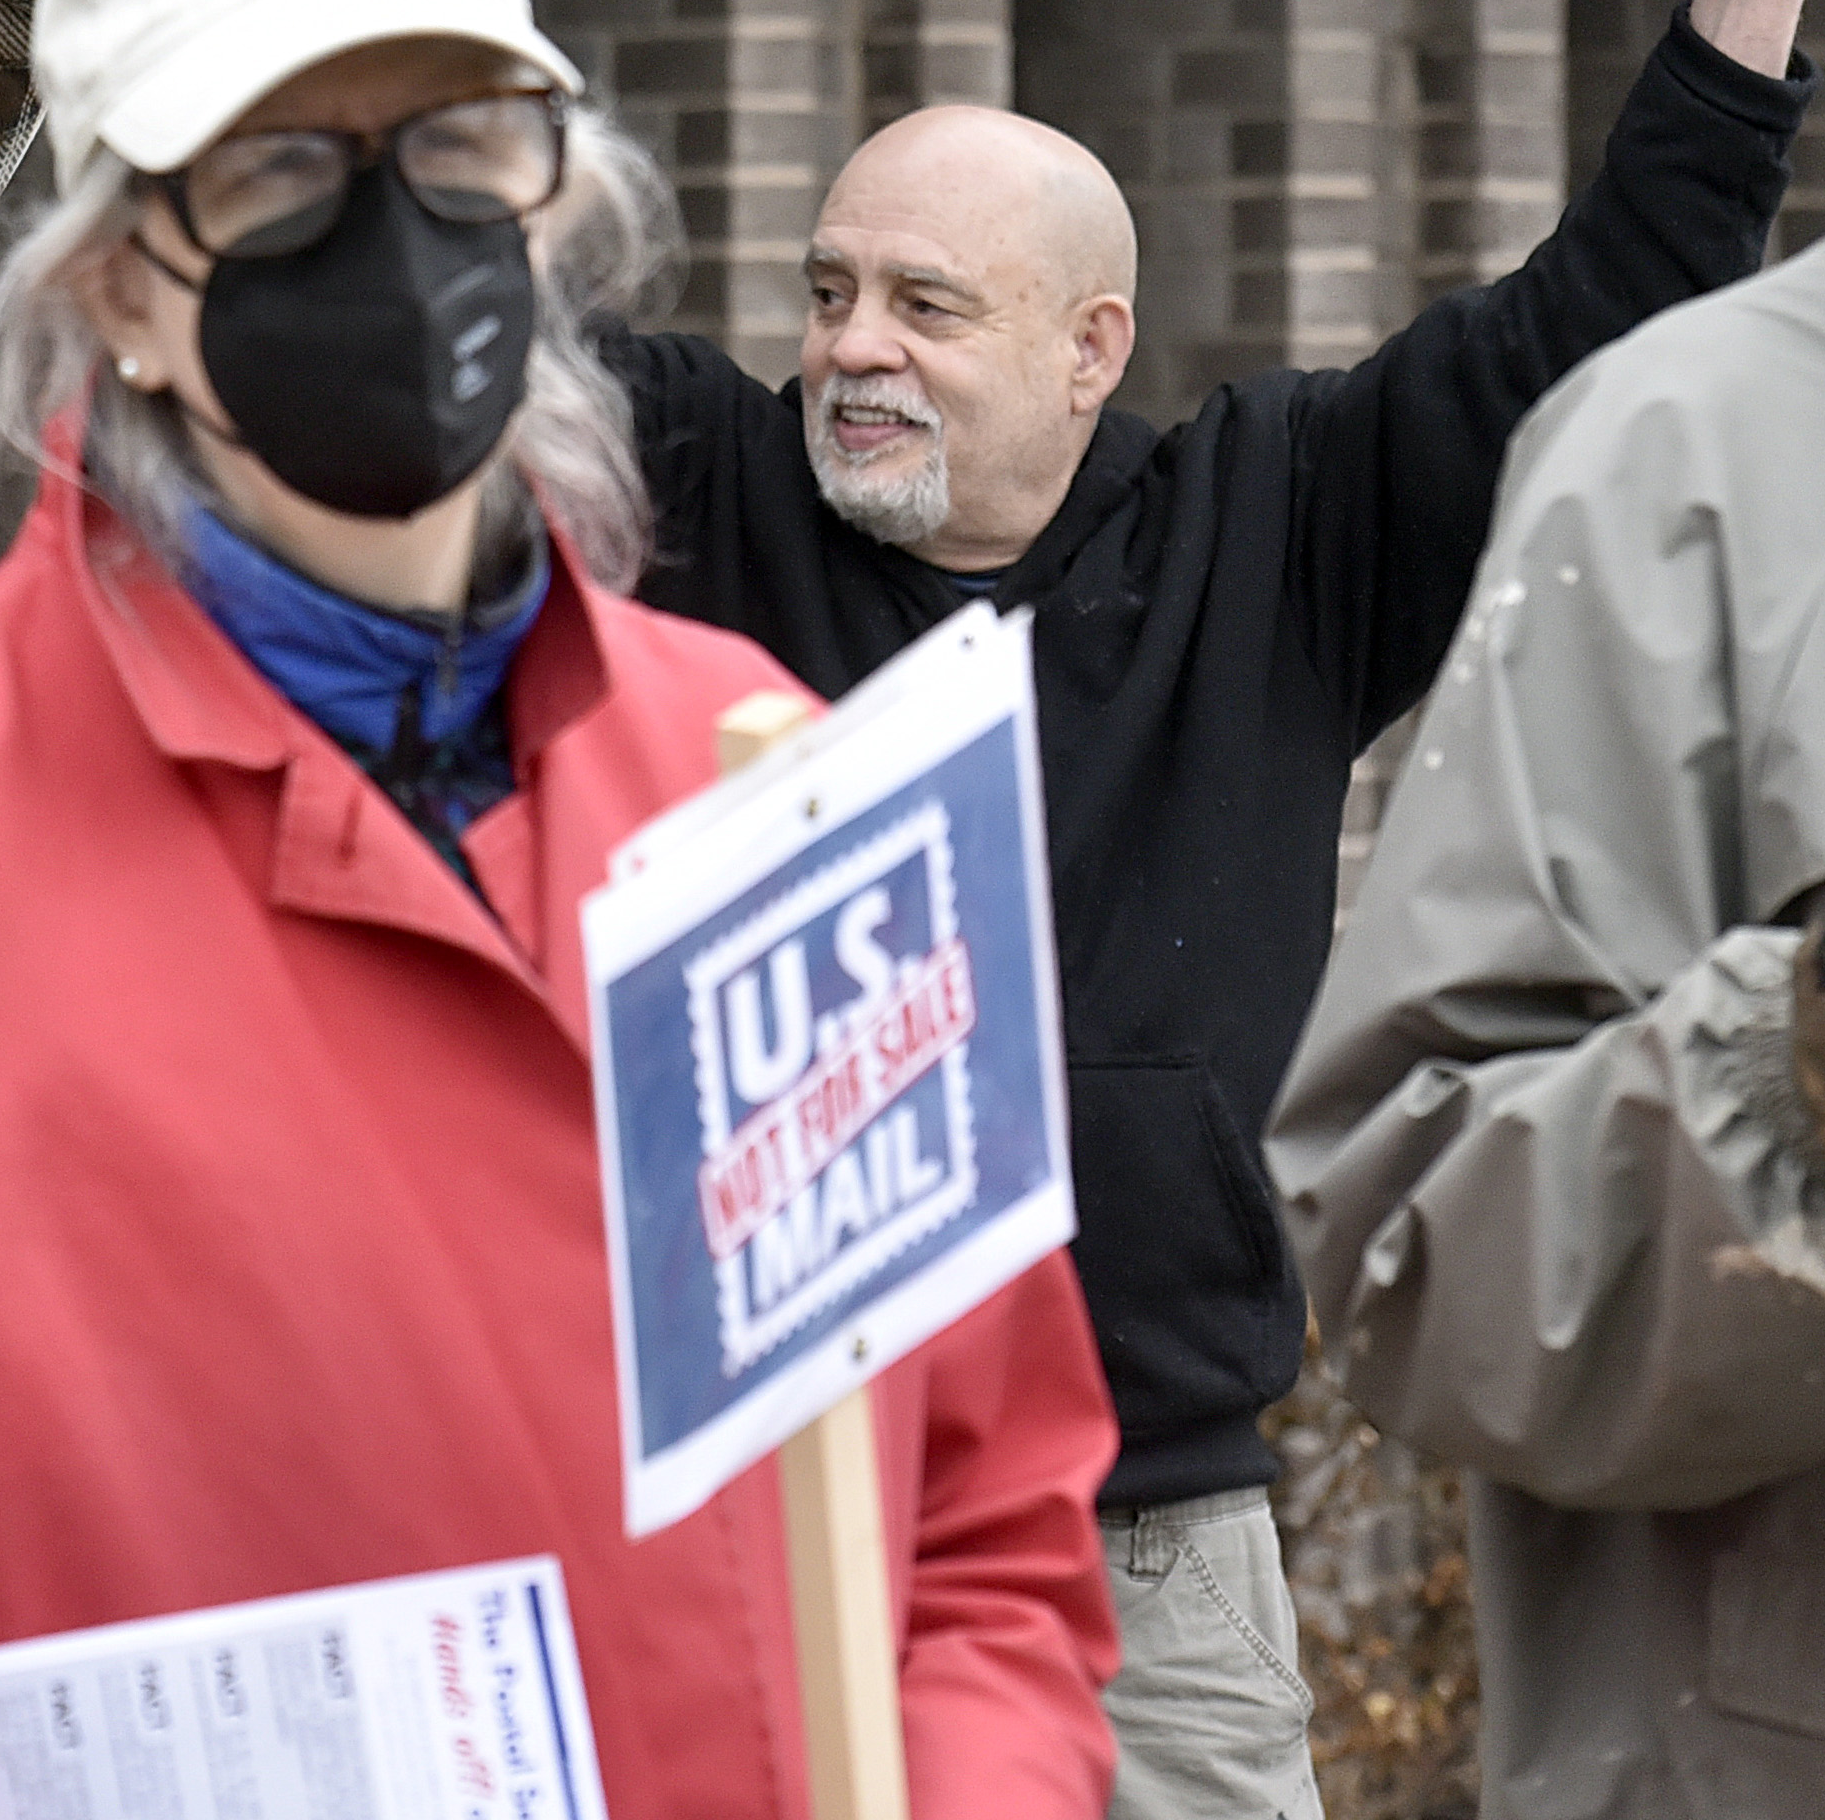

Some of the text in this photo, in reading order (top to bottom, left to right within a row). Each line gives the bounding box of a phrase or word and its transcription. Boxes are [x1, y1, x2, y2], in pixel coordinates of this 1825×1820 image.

[716, 964, 963, 1225] NOT FOR SALE
[751, 1102, 946, 1310] MAIL
